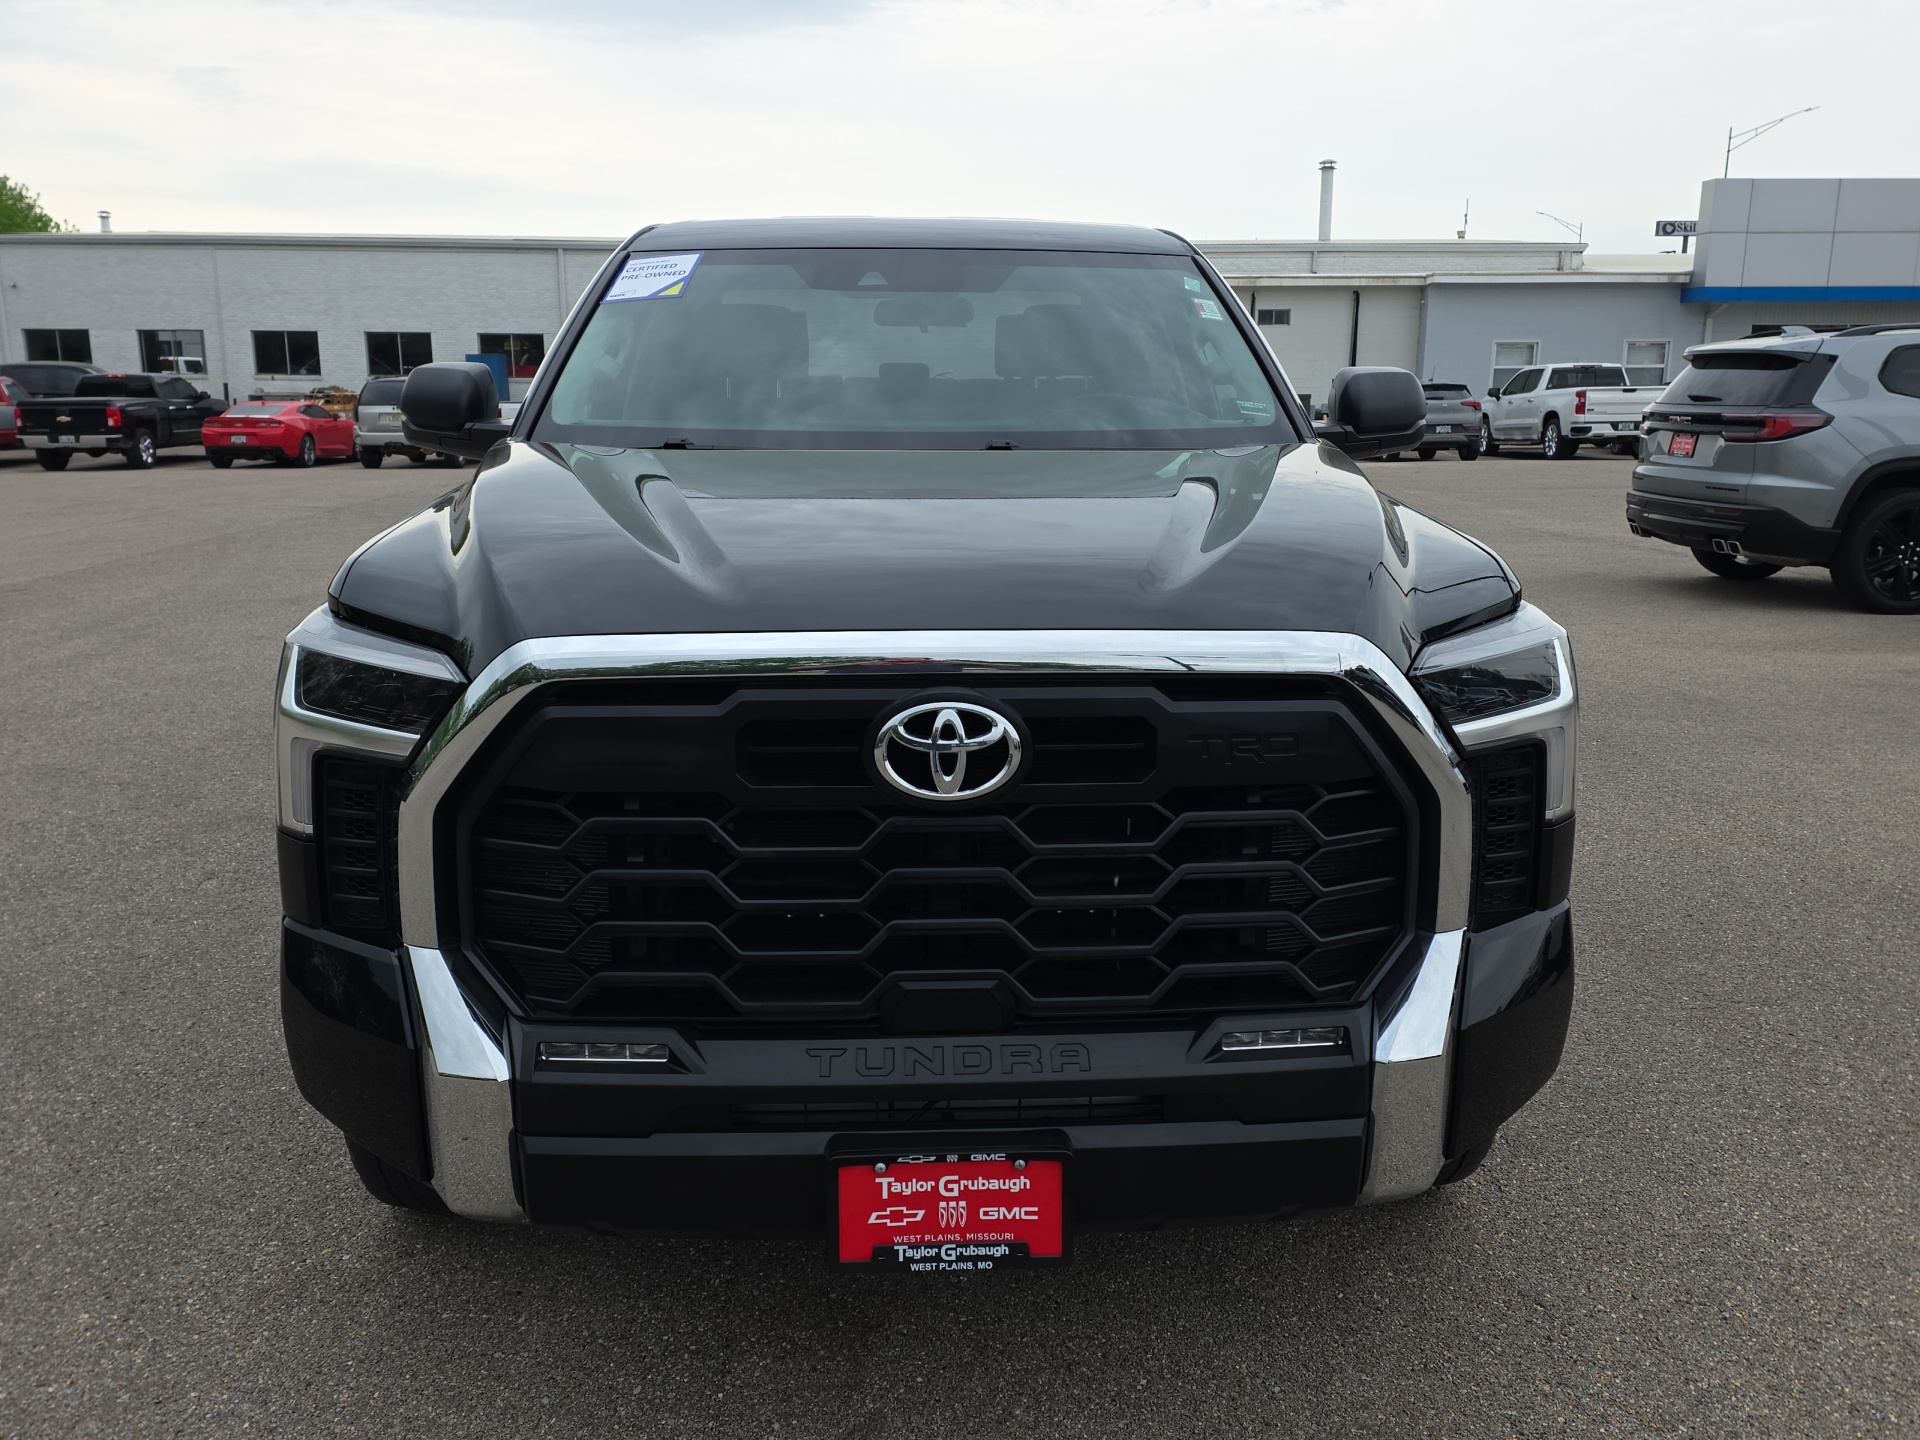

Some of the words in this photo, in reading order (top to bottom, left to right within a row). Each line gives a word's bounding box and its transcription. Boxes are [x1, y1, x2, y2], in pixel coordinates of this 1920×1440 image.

[625, 263, 678, 273] CERTIFIED
[620, 270, 687, 281] PRE-OWNED
[1187, 732, 1299, 765] TRD
[803, 1042, 1092, 1078] TUNDRA
[970, 1153, 1006, 1162] GMC
[875, 1177, 936, 1200] Taylor
[938, 1175, 1031, 1198] Grubaugh
[979, 1206, 1039, 1220] GMC
[893, 1234, 922, 1244] WEST
[924, 1233, 964, 1243] PLAINS,
[966, 1232, 1015, 1241] MISSOURI
[893, 1245, 939, 1262] Taylor
[940, 1244, 1009, 1261] Grubaugh
[910, 1262, 938, 1272] WEST
[939, 1261, 976, 1272] PLAINS,
[977, 1261, 993, 1270] MO
